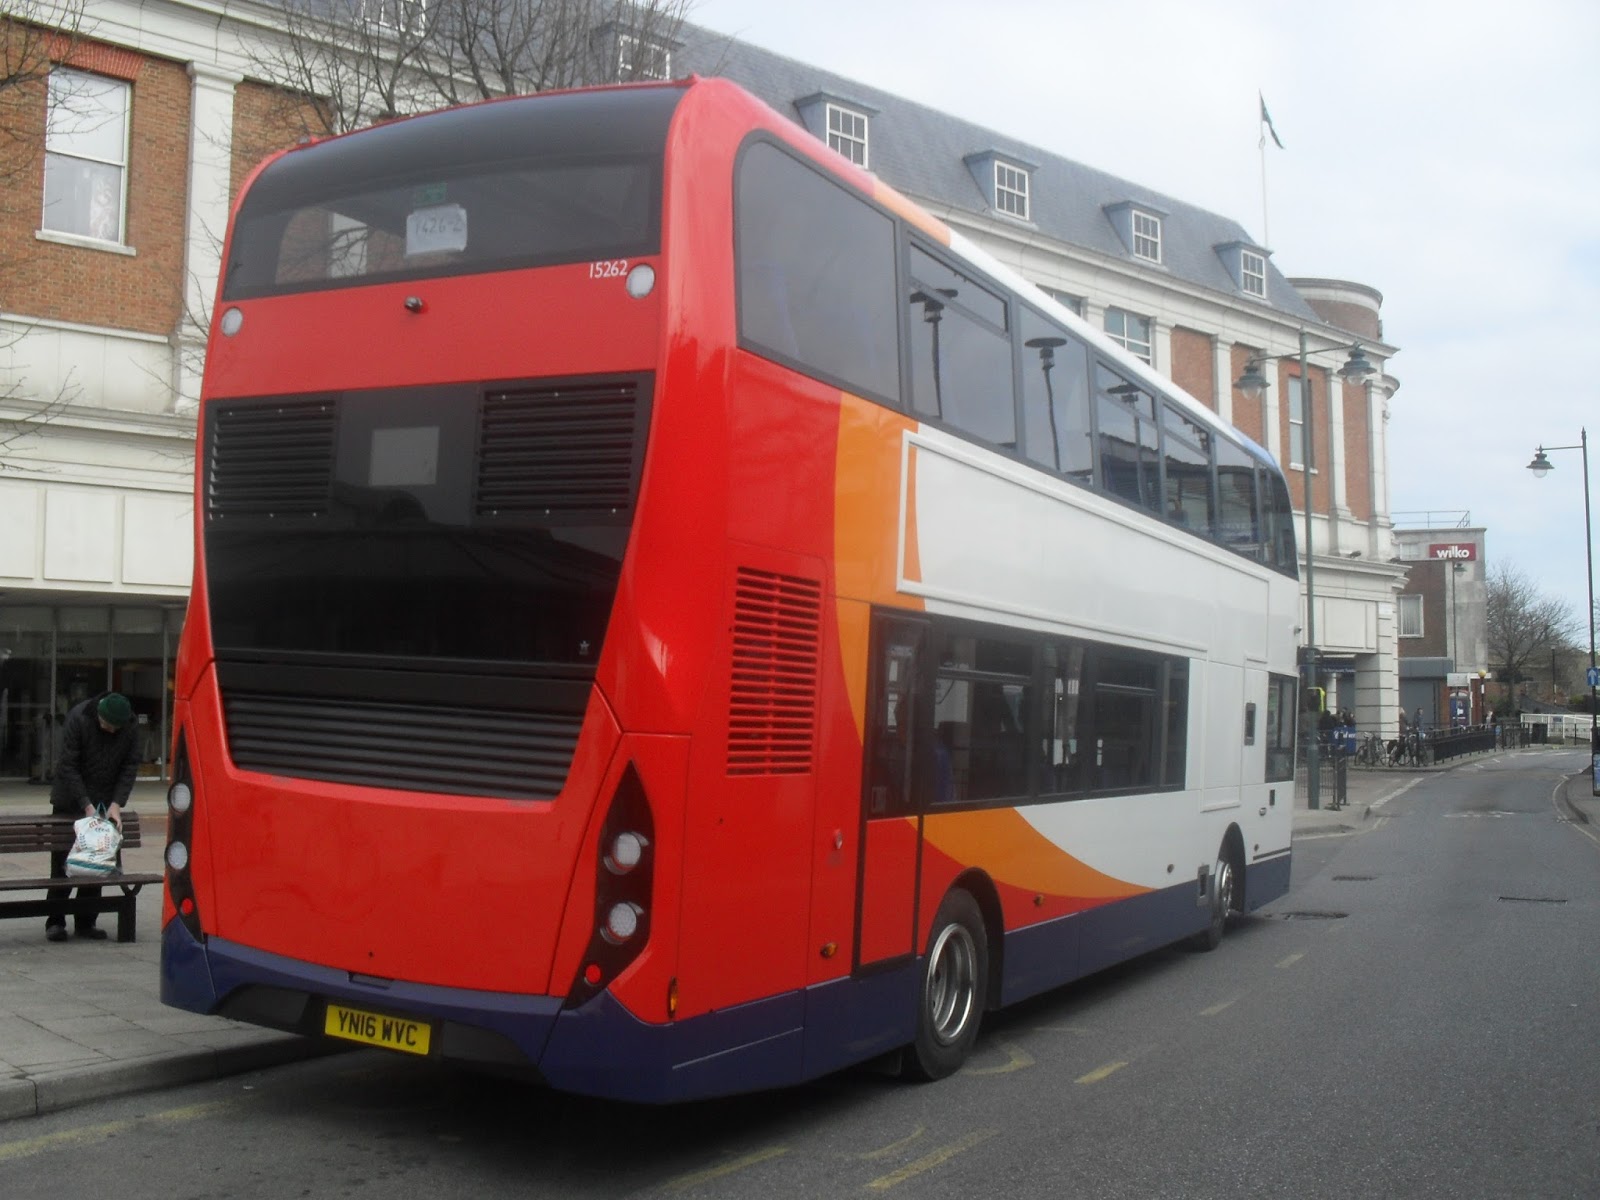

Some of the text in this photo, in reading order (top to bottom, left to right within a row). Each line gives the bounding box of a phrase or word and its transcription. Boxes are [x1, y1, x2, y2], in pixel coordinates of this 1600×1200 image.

[589, 259, 628, 279] 15262
[1436, 545, 1470, 558] wilko
[338, 1009, 418, 1046] YN16 WVC
